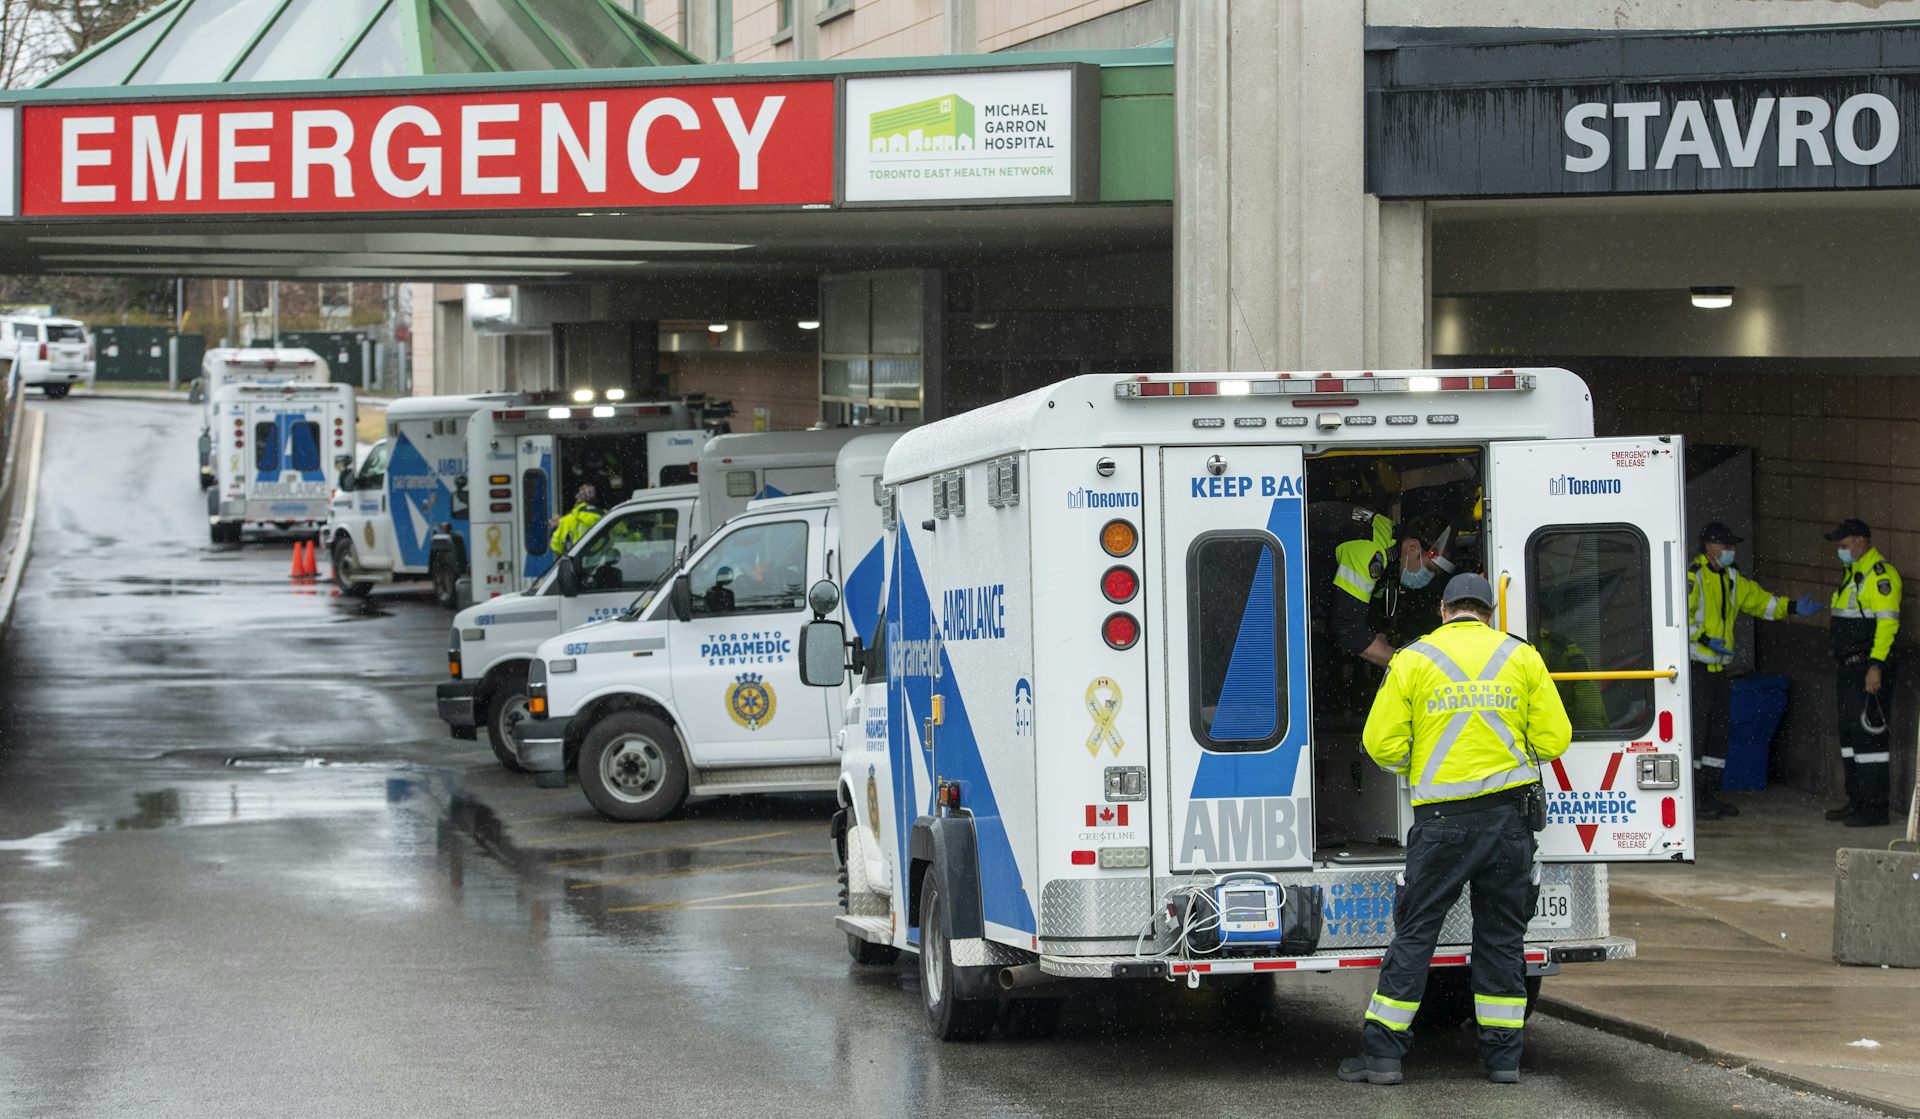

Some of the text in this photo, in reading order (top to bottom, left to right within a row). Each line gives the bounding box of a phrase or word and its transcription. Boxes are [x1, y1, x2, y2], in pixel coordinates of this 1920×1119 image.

[985, 103, 1048, 117] MICHAEL
[985, 120, 1046, 133] GARRON
[1564, 93, 1900, 173] STAVRO
[61, 96, 786, 203] EMERGENCY
[985, 136, 1054, 150] HOSPITAL
[869, 166, 1054, 179] TORONTO EAST HEALTH NETWORK
[1611, 450, 1651, 460] EMERGENCY
[1616, 459, 1645, 467] RELEASE
[1191, 476, 1254, 498] KEEP
[1567, 477, 1621, 495] TORONTO
[1085, 490, 1139, 508] TORONTO
[943, 584, 1005, 641] AMBULANCE
[708, 631, 782, 642] TORONTO
[566, 642, 589, 656] 957
[701, 639, 791, 658] PARAMEDIC
[708, 654, 784, 667] SERVICES
[888, 622, 943, 690] paramedic
[1433, 684, 1512, 697] TORONTO
[1427, 693, 1518, 714] PARAMEDIC
[1546, 791, 1627, 800] TORONTO
[1545, 800, 1637, 815] ARAMEDIC
[1546, 815, 1629, 824] SERVICES
[1078, 831, 1136, 844] CRESTLINE
[1612, 832, 1652, 841] EMERGENCY
[1617, 841, 1646, 849] RELEASE
